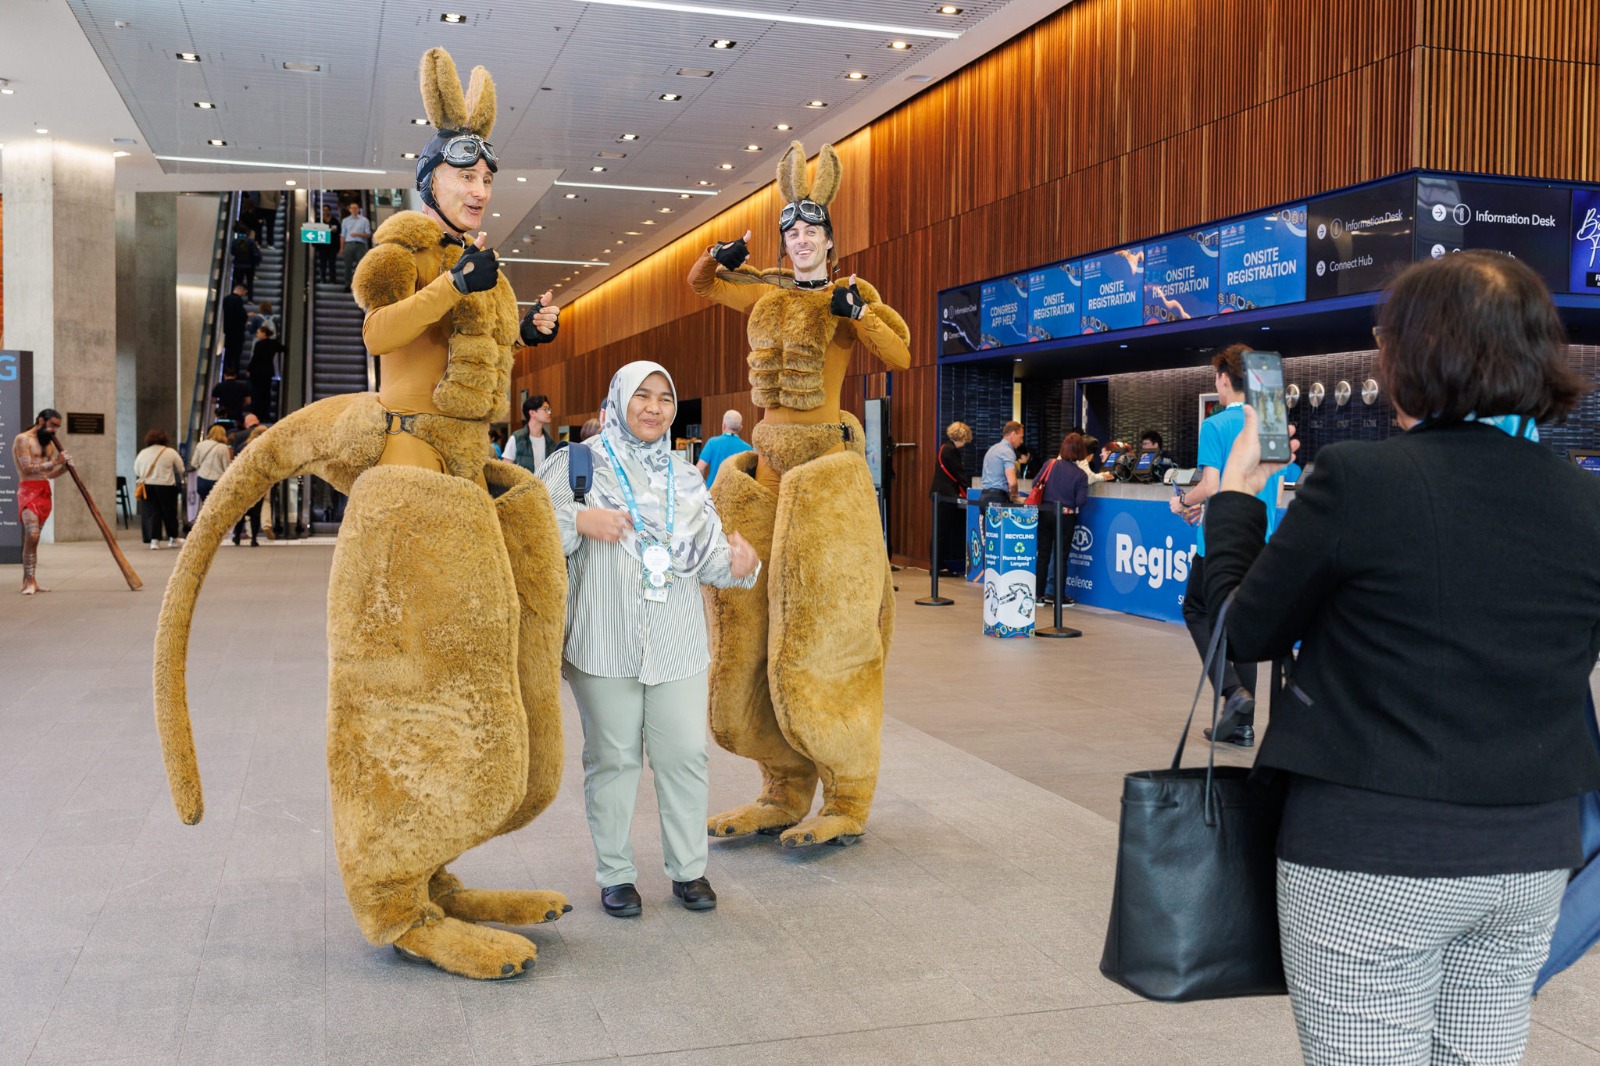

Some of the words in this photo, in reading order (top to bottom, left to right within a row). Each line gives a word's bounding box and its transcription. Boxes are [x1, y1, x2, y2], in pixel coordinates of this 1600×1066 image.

[1345, 215, 1384, 231] Information
[1385, 208, 1403, 222] Desk
[1475, 209, 1530, 225] Information
[1531, 213, 1556, 227] Desk
[1243, 246, 1279, 267] ONSITE
[1329, 259, 1358, 272] Connect
[1358, 253, 1373, 267] Hub
[1165, 265, 1195, 283] ONSITE
[1227, 259, 1297, 286] REGISTRATION
[1099, 280, 1124, 295] ONSITE
[1152, 276, 1209, 299] REGISTRATION
[1043, 292, 1065, 306] ONSITE
[1088, 290, 1136, 310] REGISTRATION
[990, 302, 1018, 317] CONGRESS
[1033, 302, 1075, 320] REGISTRATION
[991, 317, 1002, 328] APP
[1002, 313, 1016, 326] HELP
[0, 354, 17, 381] G
[1072, 530, 1089, 545] ADA
